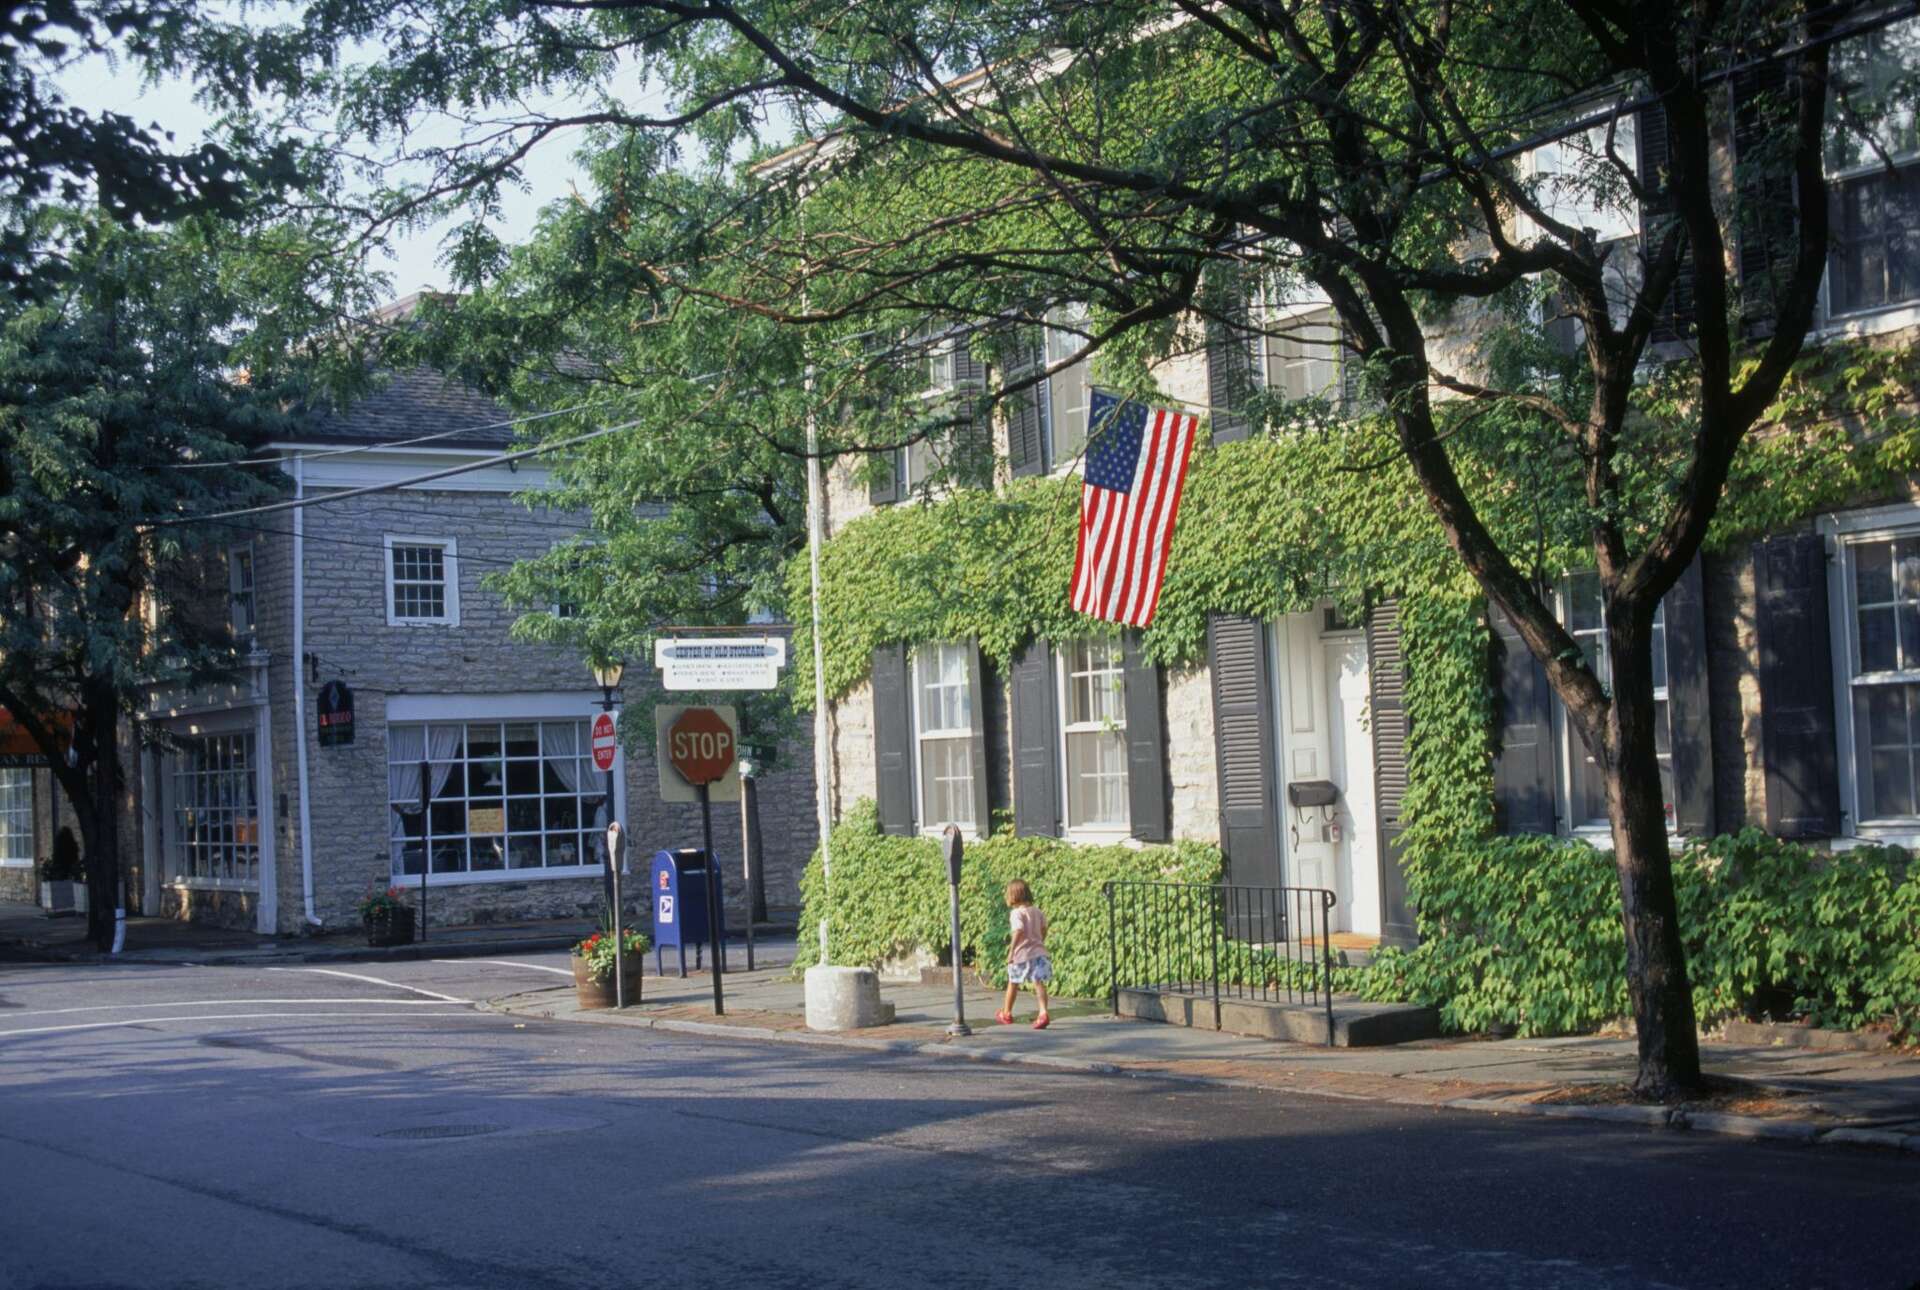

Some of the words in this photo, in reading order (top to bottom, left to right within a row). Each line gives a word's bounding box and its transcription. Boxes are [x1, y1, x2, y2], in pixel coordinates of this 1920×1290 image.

[675, 646, 702, 658] CENTER
[704, 646, 713, 658] OF
[715, 645, 728, 658] OLD
[729, 645, 765, 657] STOCKADE
[595, 726, 602, 737] DO
[603, 724, 613, 736] NOT
[675, 732, 730, 759] STOP
[736, 744, 753, 757] OHN
[597, 750, 612, 760] ENTER
